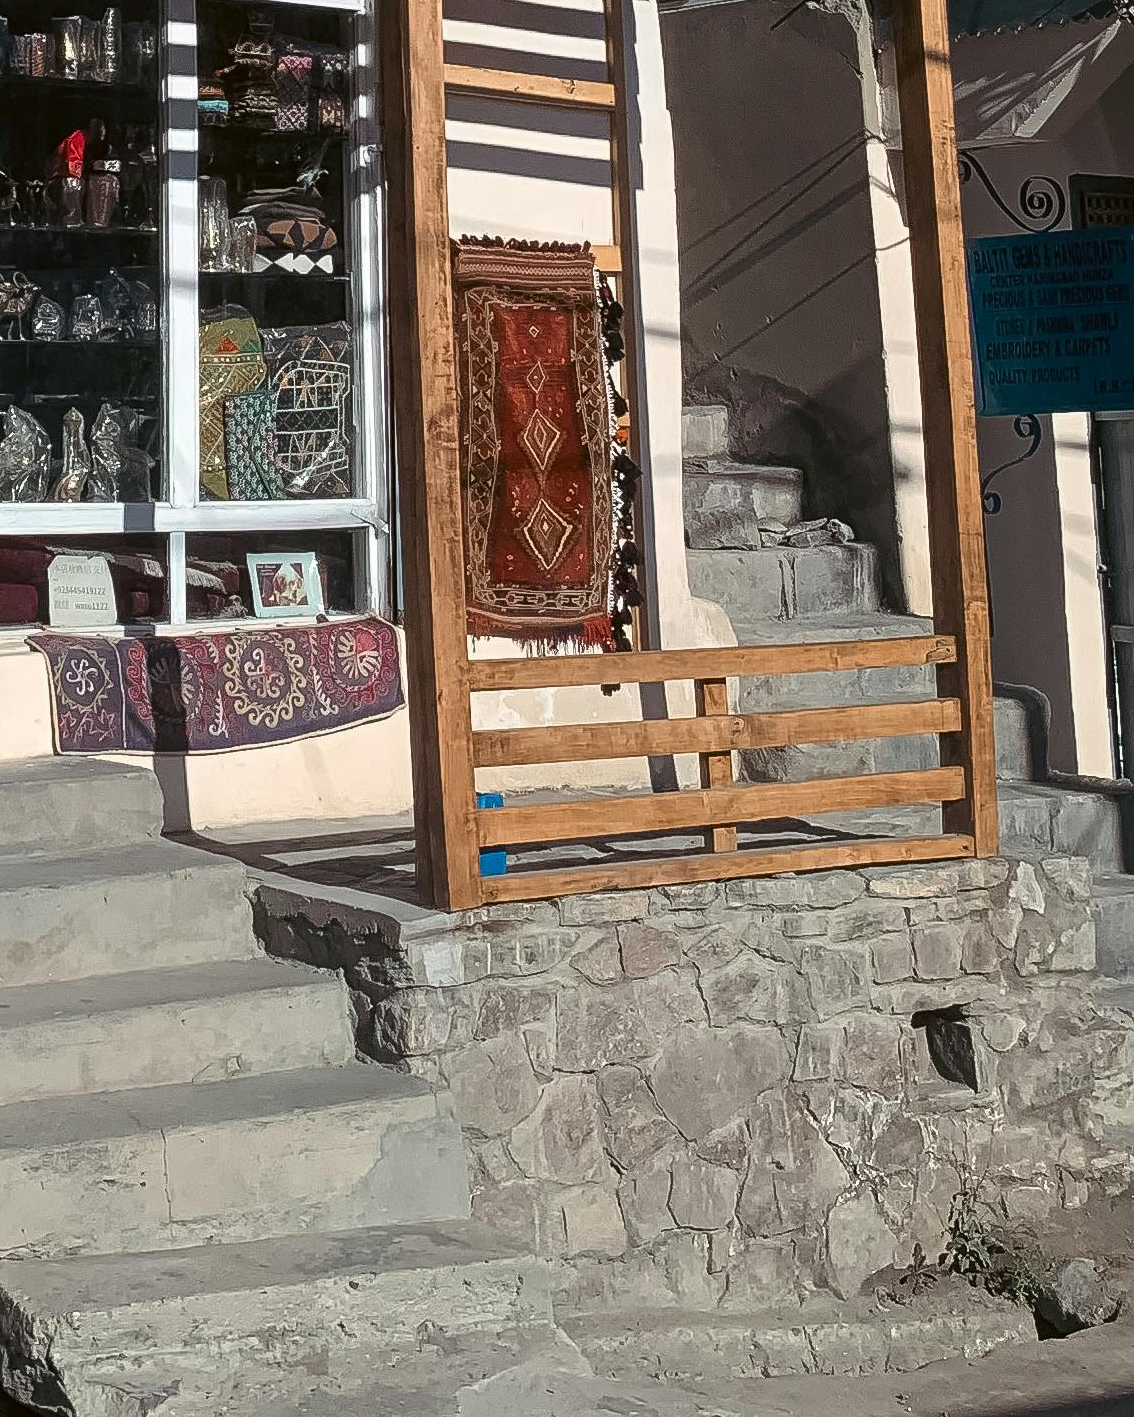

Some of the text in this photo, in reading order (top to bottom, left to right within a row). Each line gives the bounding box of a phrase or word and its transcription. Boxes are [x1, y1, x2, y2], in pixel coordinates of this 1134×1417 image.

[972, 238, 1128, 274] BALTIT GEMS & HANDICRAFTS
[989, 273, 1024, 288] CENTER
[982, 290, 1026, 310] PRECIOUS
[1028, 289, 1035, 307] &
[1060, 285, 1104, 305] PRECIOUS
[995, 317, 1025, 337] STONES
[1080, 311, 1120, 332] SHAWLS
[986, 337, 1111, 361] EMBROIDERY & CARPETS
[988, 365, 1081, 386] QUALITY PRODUCTS
